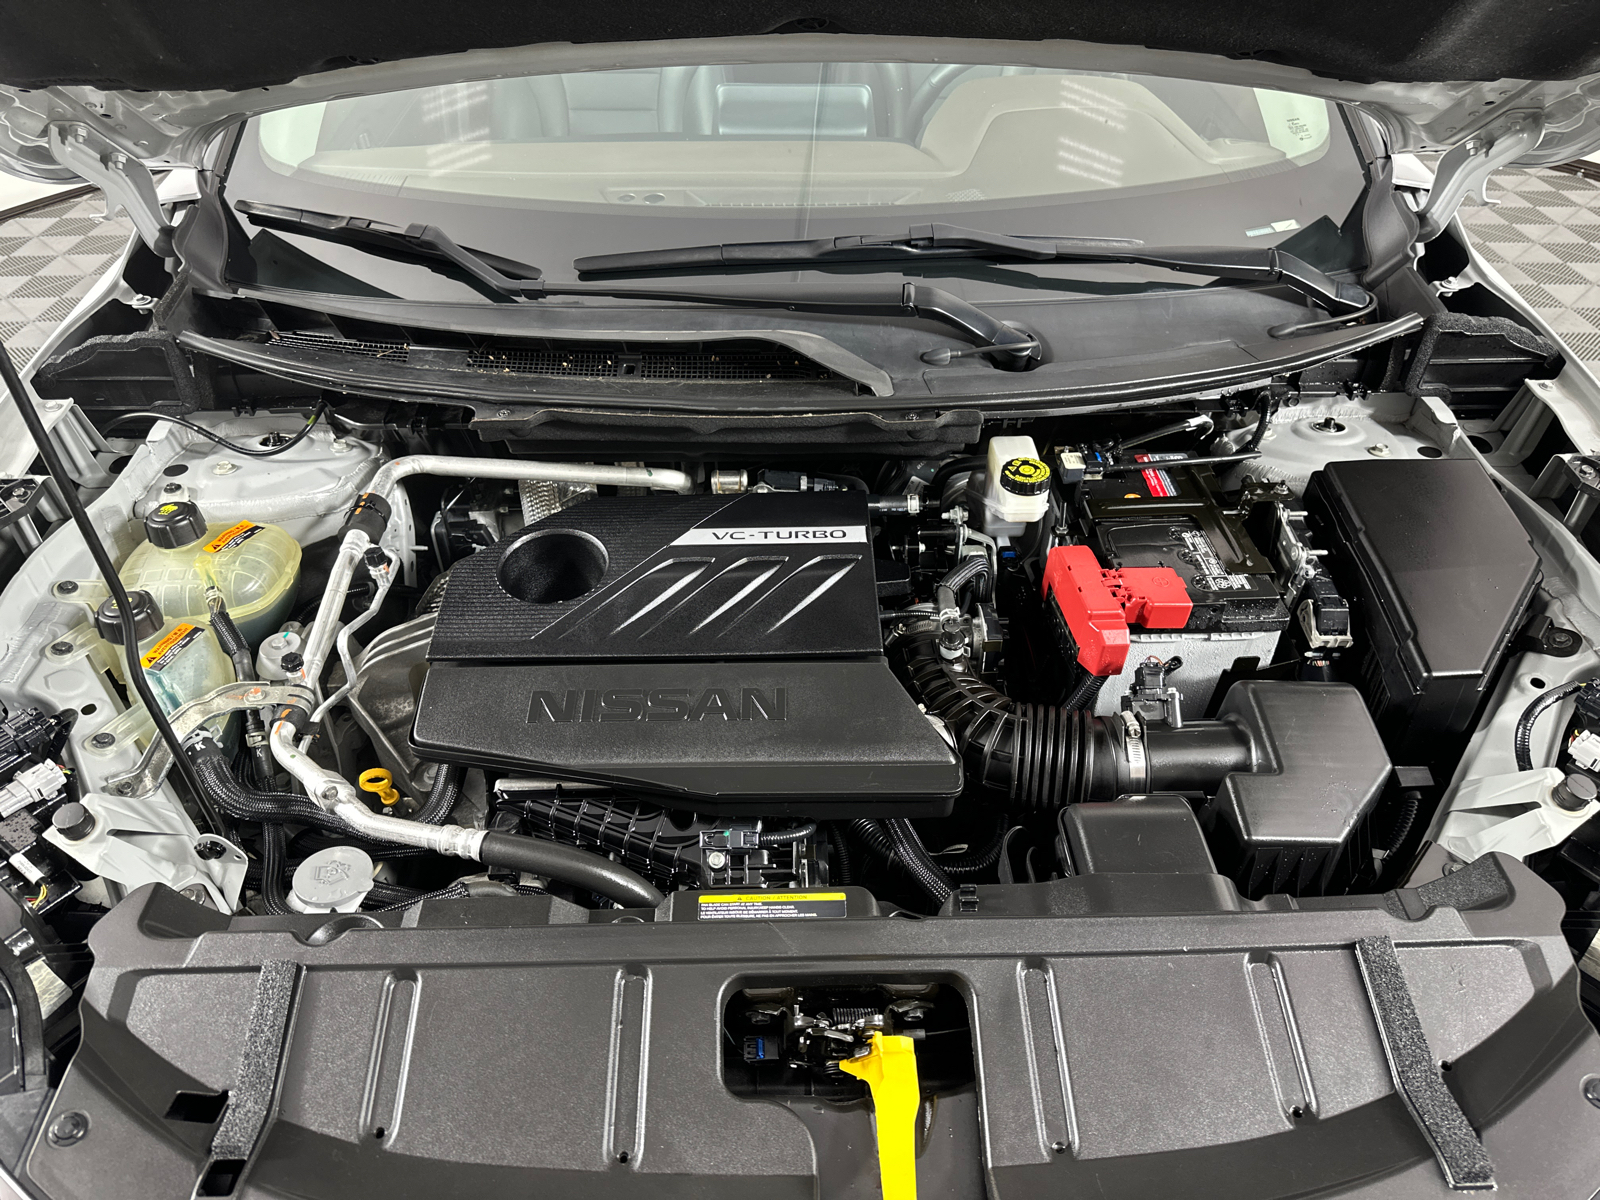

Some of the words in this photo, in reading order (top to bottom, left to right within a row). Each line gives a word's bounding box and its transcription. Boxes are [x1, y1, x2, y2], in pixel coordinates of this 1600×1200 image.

[712, 529, 847, 540] VC-TURBO
[525, 687, 787, 723] NISSAN
[194, 741, 206, 751] K
[256, 748, 262, 757] K
